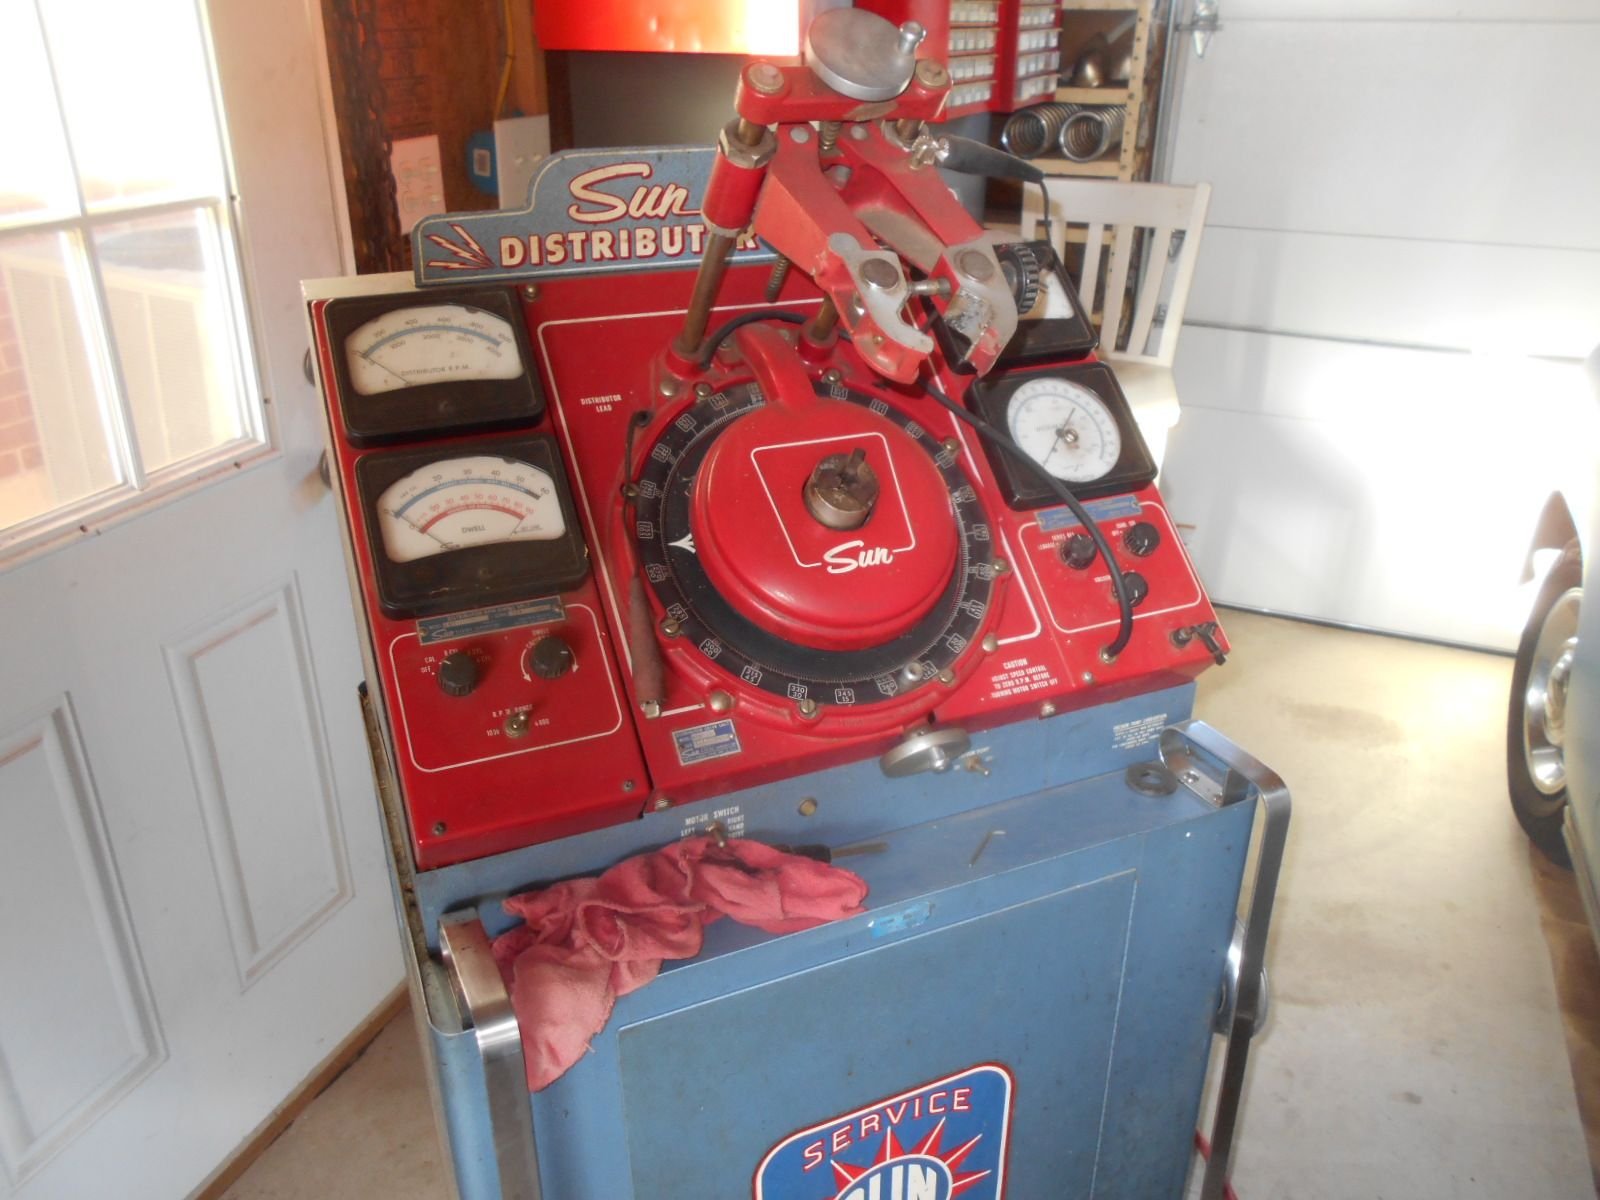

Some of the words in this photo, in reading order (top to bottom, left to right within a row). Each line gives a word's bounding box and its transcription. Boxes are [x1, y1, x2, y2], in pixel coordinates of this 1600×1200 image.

[568, 162, 703, 224] Sun
[500, 224, 757, 268] DISTRIBUTR
[580, 394, 622, 405] DISTRIBUTOR
[596, 404, 612, 412] LEAD
[462, 525, 486, 534] DWELL
[824, 540, 893, 574] Sun
[1003, 658, 1028, 670] CAUTION
[791, 686, 804, 694] 330
[1030, 681, 1048, 690] SWITCH
[685, 814, 708, 826] MOTOR
[714, 806, 740, 818] SWITCH
[804, 1088, 971, 1170] SERVICE
